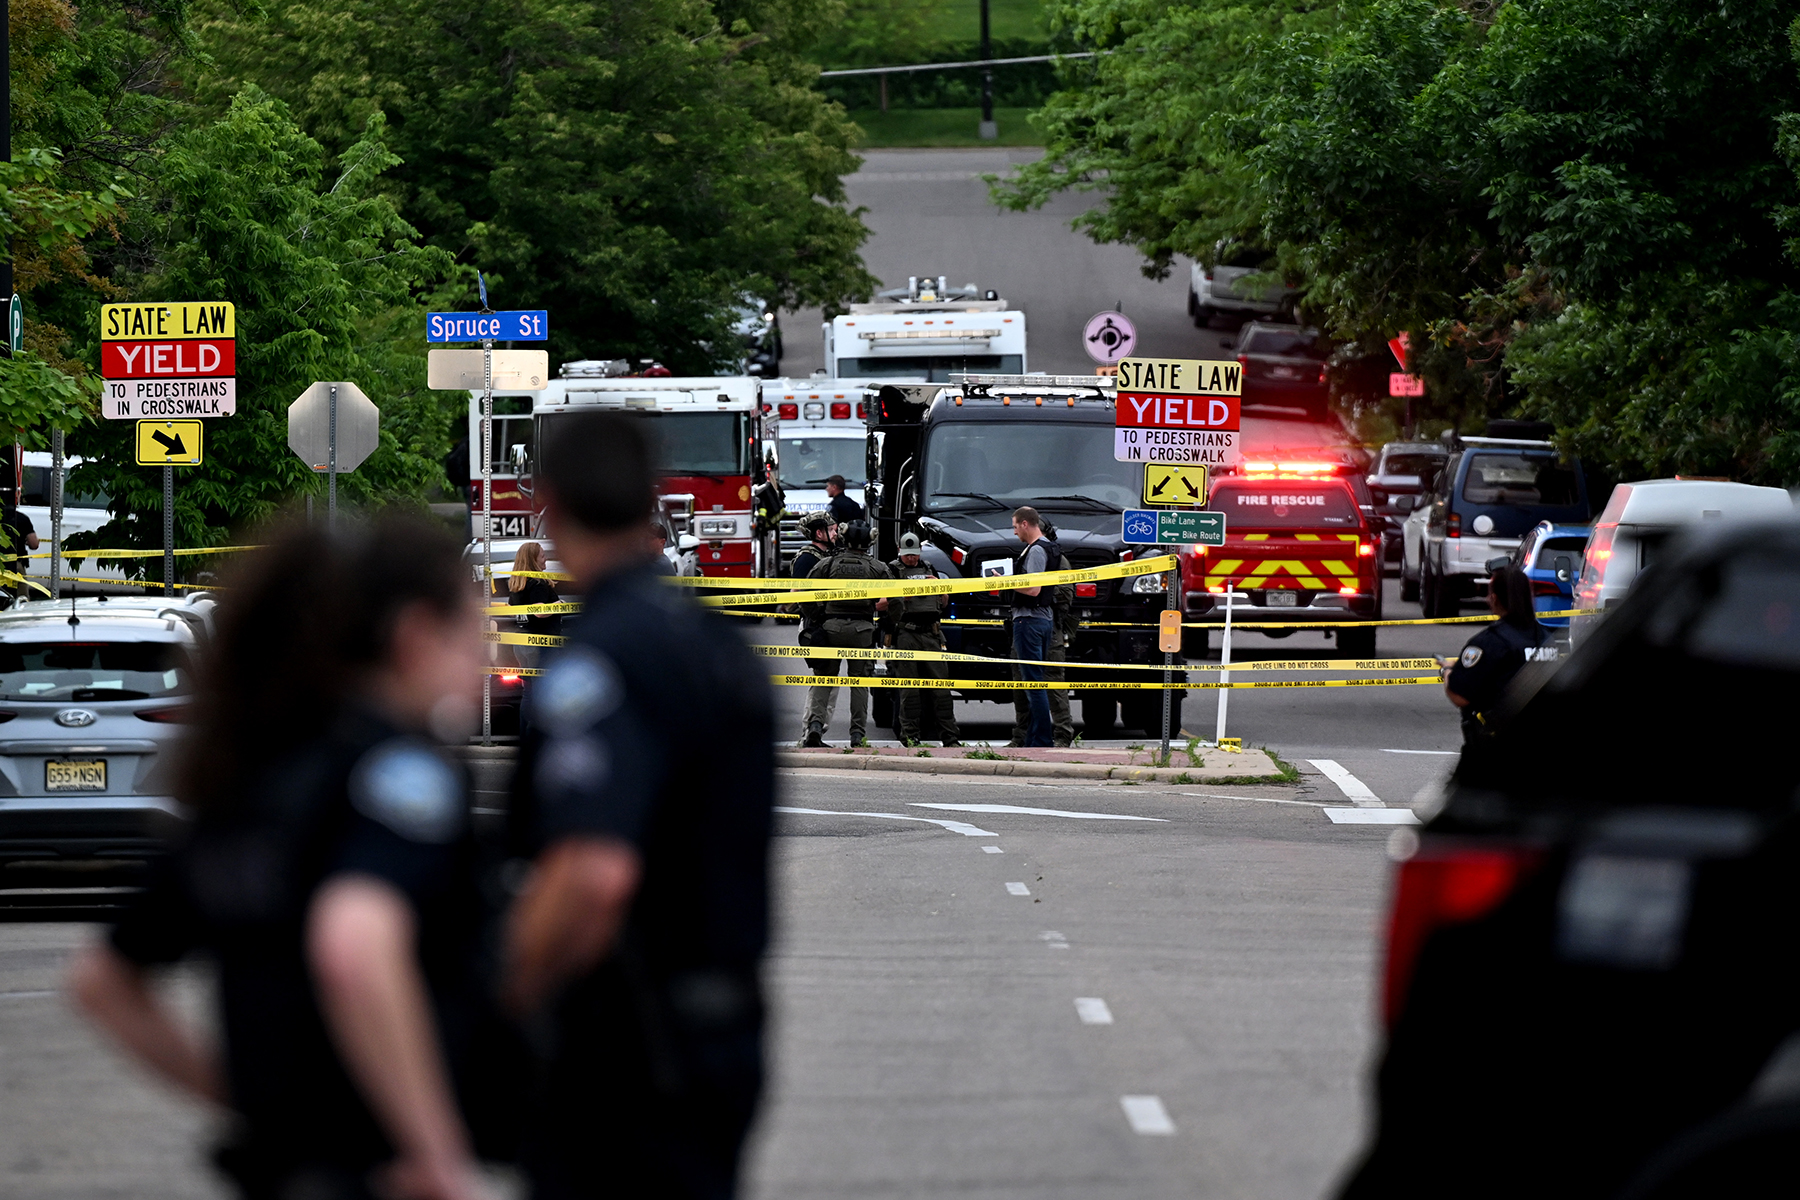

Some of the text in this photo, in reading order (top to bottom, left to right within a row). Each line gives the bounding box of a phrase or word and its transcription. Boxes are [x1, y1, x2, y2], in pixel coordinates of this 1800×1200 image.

[108, 306, 226, 336] STATE LAW
[431, 314, 541, 341] Spruce St
[116, 344, 221, 374] YIELD
[1119, 362, 1240, 391] STATE LAW
[111, 382, 227, 398] TO PEDESTRIANS
[118, 399, 219, 415] IN CROSSWALK
[1128, 397, 1229, 426] YIELD
[1123, 430, 1232, 447] TO PEDESTRIANS
[1128, 446, 1225, 462] IN CROSSWALK
[1238, 495, 1325, 506] FIRE RESCUE
[490, 517, 525, 536] E141
[1161, 516, 1195, 525] Bike Lane
[1182, 531, 1221, 540] Bike Route
[528, 636, 547, 645] POLICE
[769, 647, 778, 655] DO
[779, 647, 790, 655] NOT
[791, 648, 810, 656] CROSS
[859, 650, 871, 658] LINE
[1401, 660, 1411, 668] NOT
[1412, 660, 1432, 668] CROSS
[840, 677, 860, 685] POLICE
[79, 768, 102, 783] NSN
